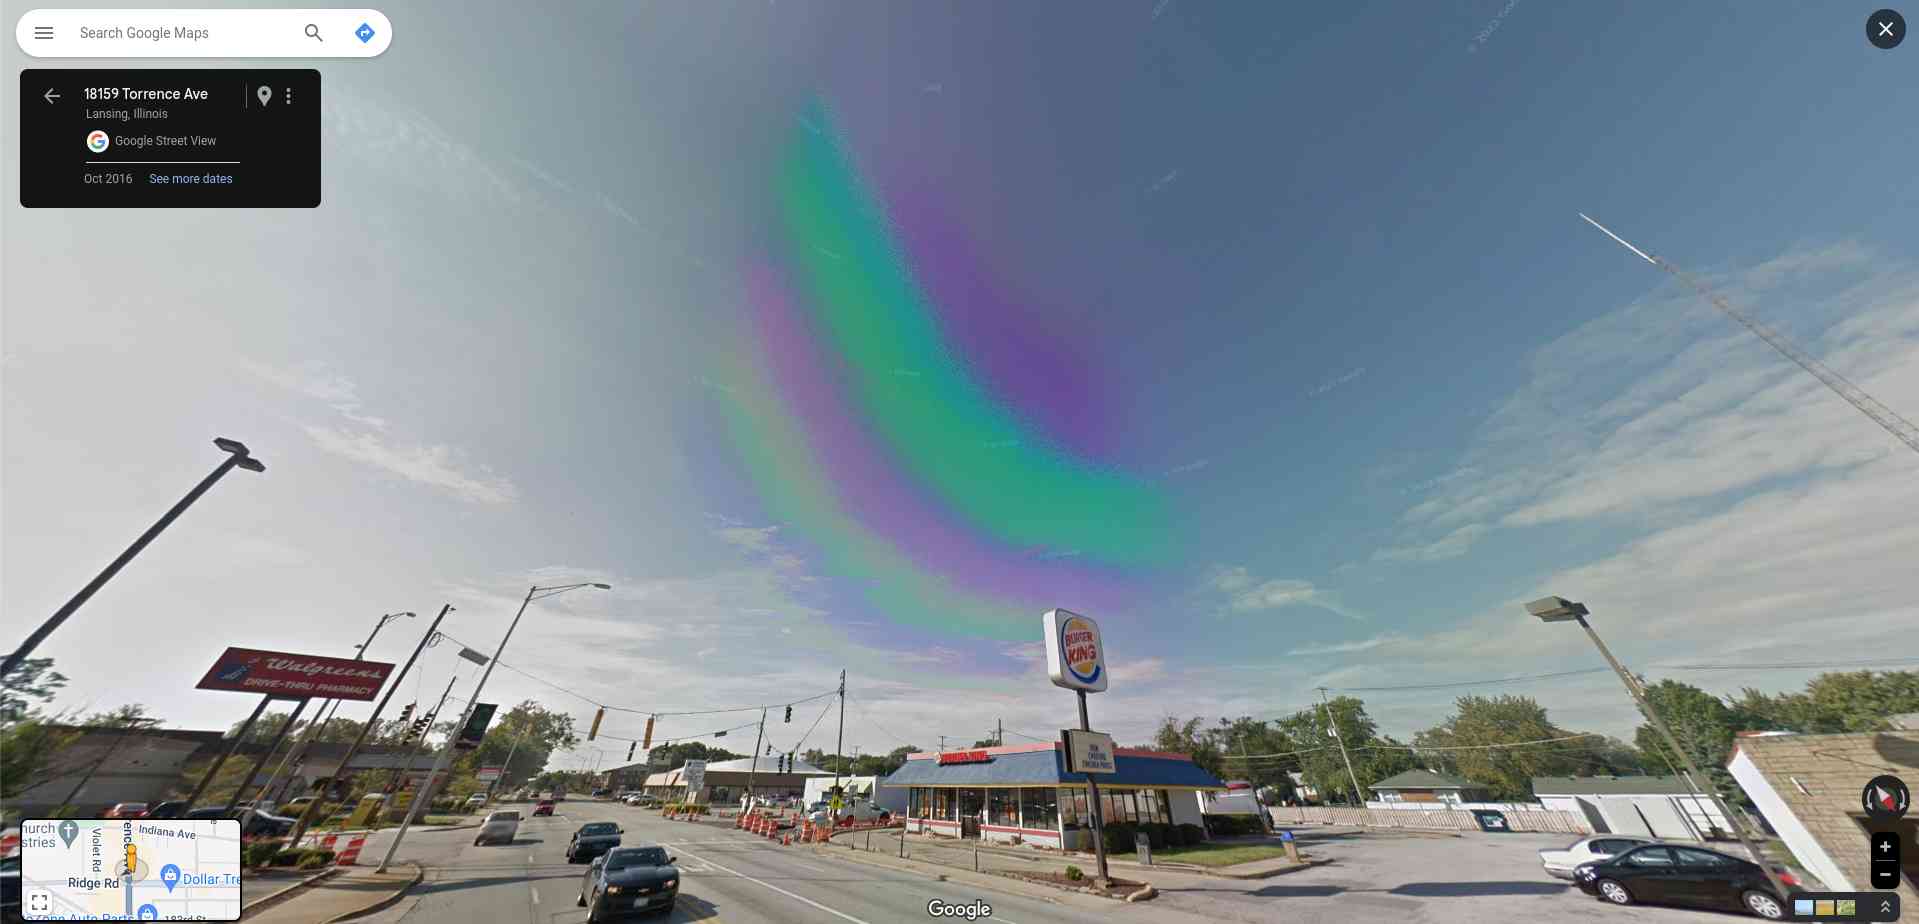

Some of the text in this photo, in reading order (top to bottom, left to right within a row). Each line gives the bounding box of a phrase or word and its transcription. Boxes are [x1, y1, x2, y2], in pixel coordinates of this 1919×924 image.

[1065, 631, 1094, 647] BURGER
[1068, 645, 1097, 665] KING
[266, 658, 383, 679] Walgreens
[243, 677, 375, 696] DRIVE-THRU PHARMACY
